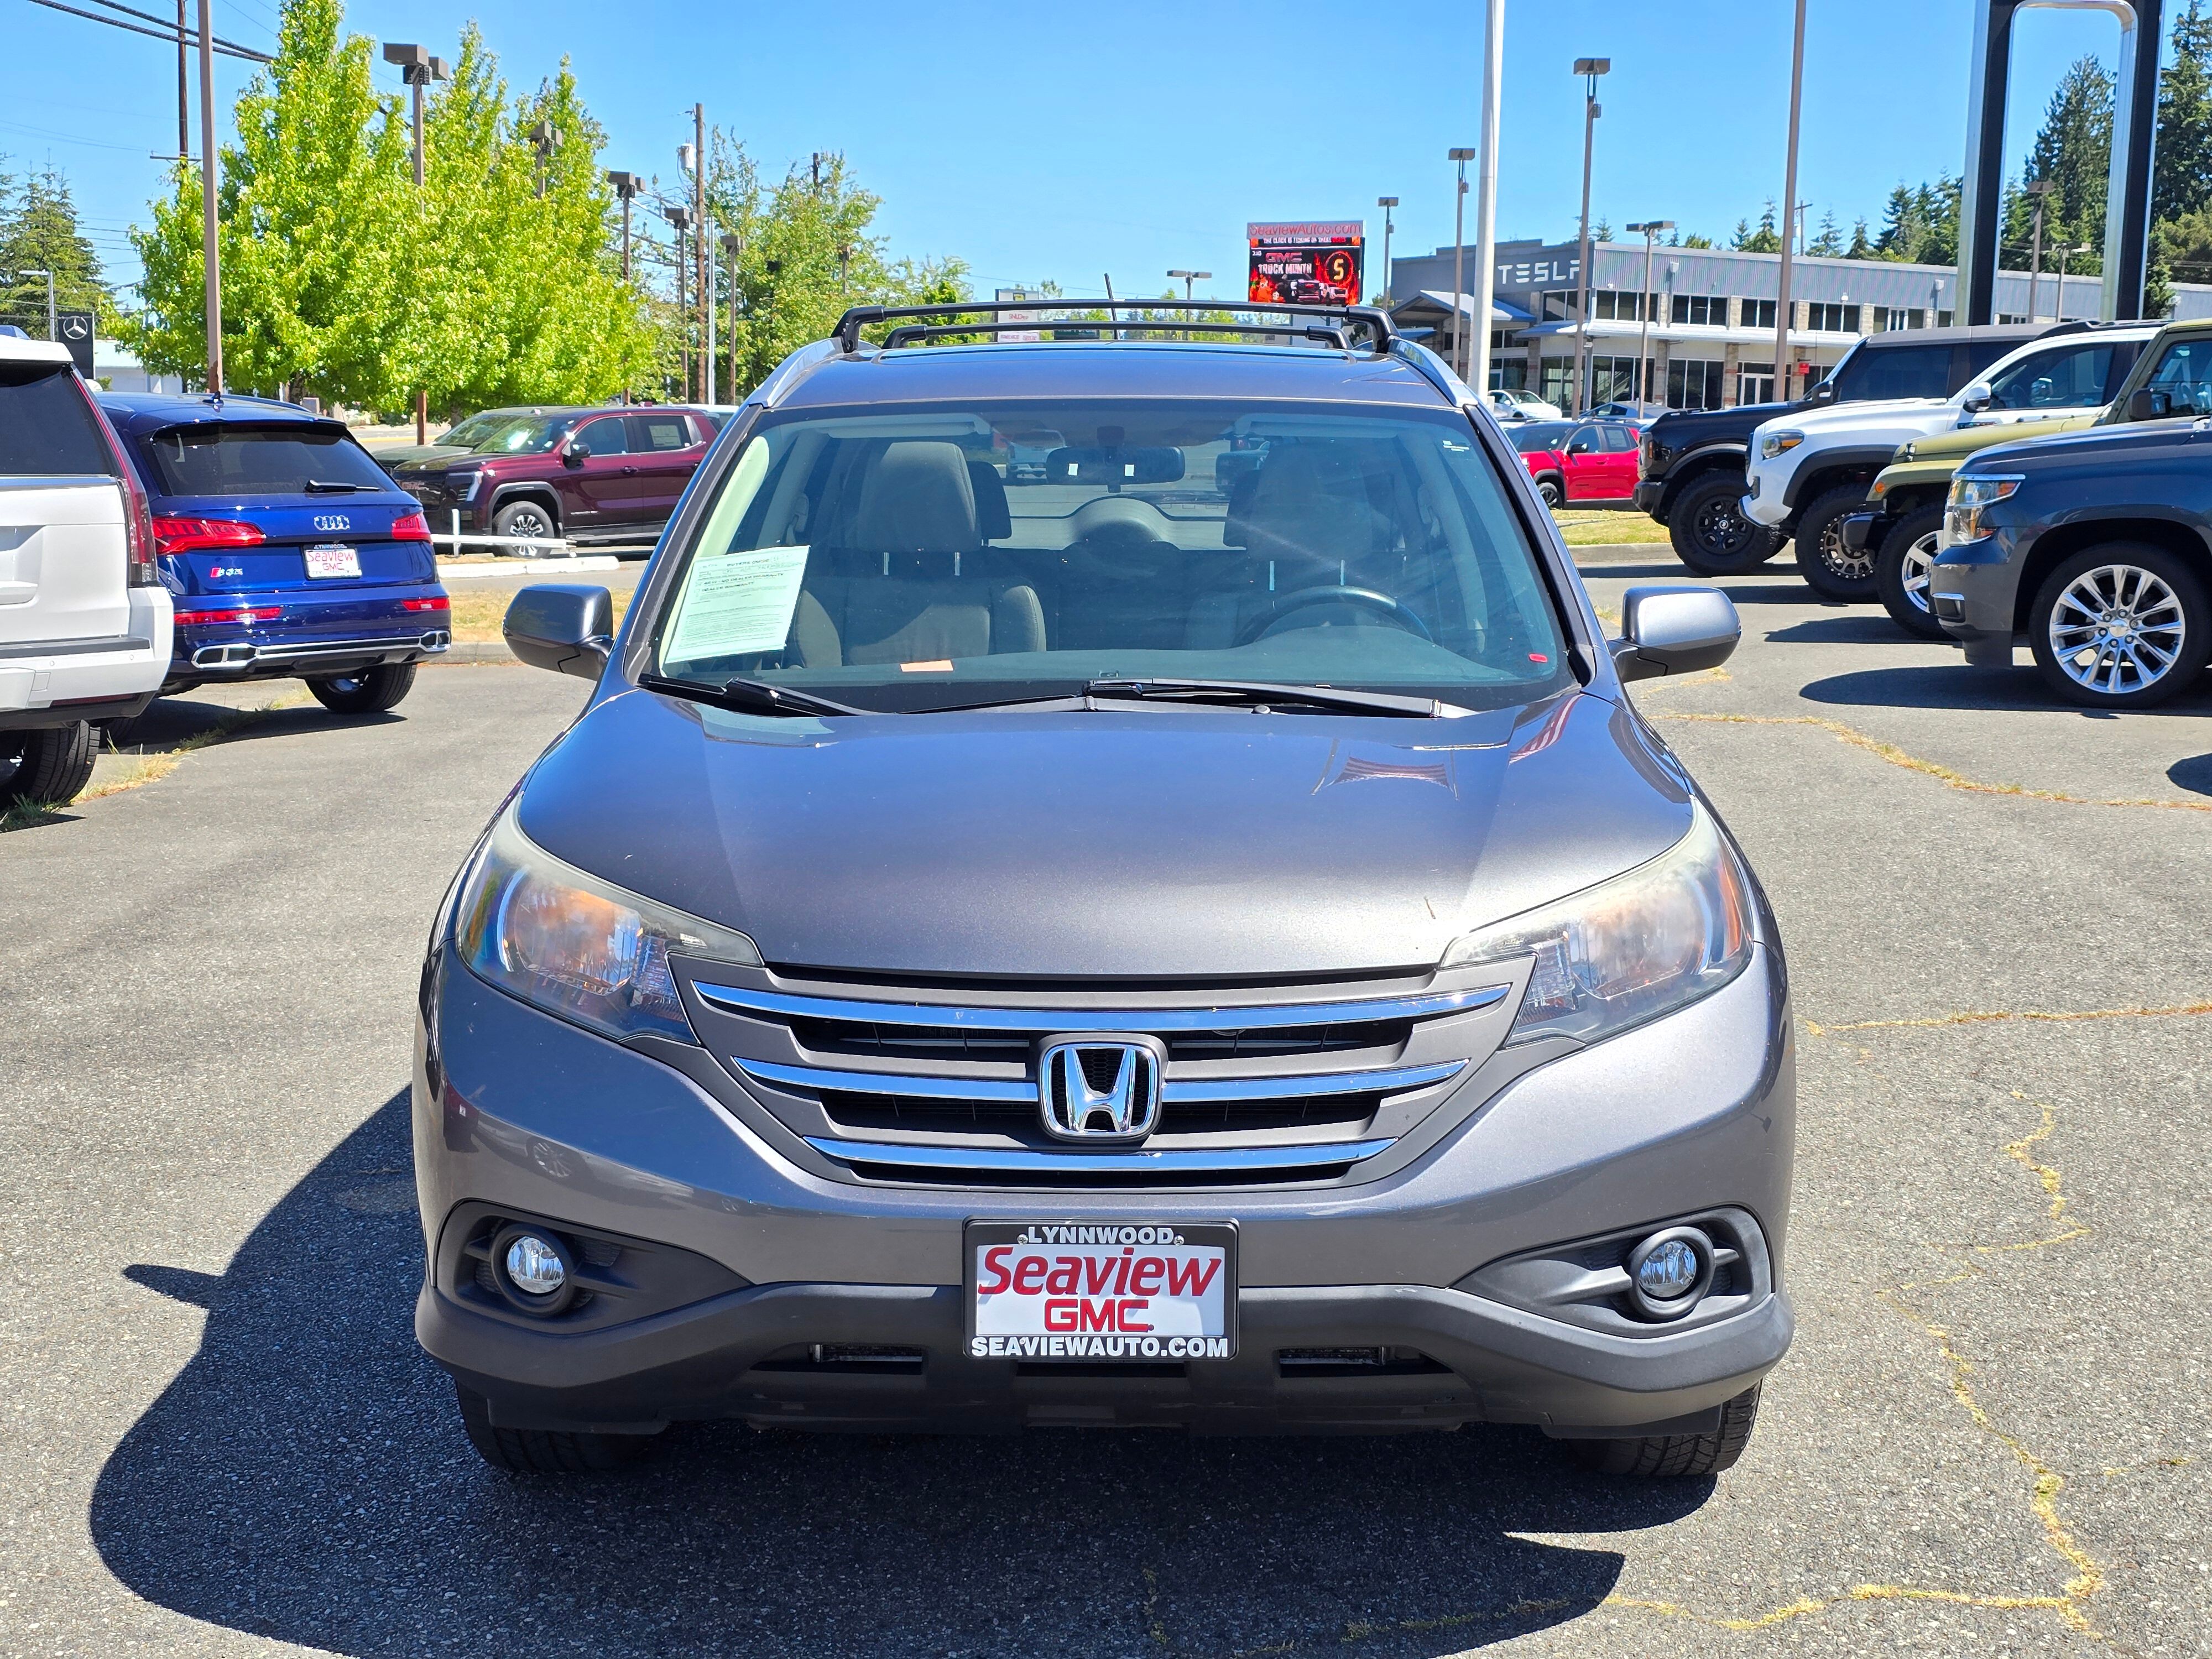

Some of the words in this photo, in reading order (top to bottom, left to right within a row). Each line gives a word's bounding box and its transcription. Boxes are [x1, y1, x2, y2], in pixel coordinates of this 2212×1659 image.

[1249, 223, 1361, 236] SeaviewAutos.com
[1265, 252, 1302, 263] GMC
[1258, 264, 1284, 274] TRUCK
[1497, 259, 1580, 284] TESLA
[306, 550, 354, 562] Seaview
[322, 562, 345, 571] GMC
[1027, 1226, 1173, 1244] LYNNWOOD
[978, 1246, 1222, 1296] Seaview
[1044, 1298, 1150, 1333] GMC
[971, 1337, 1229, 1358] SEAVIEWAUTO.COM
